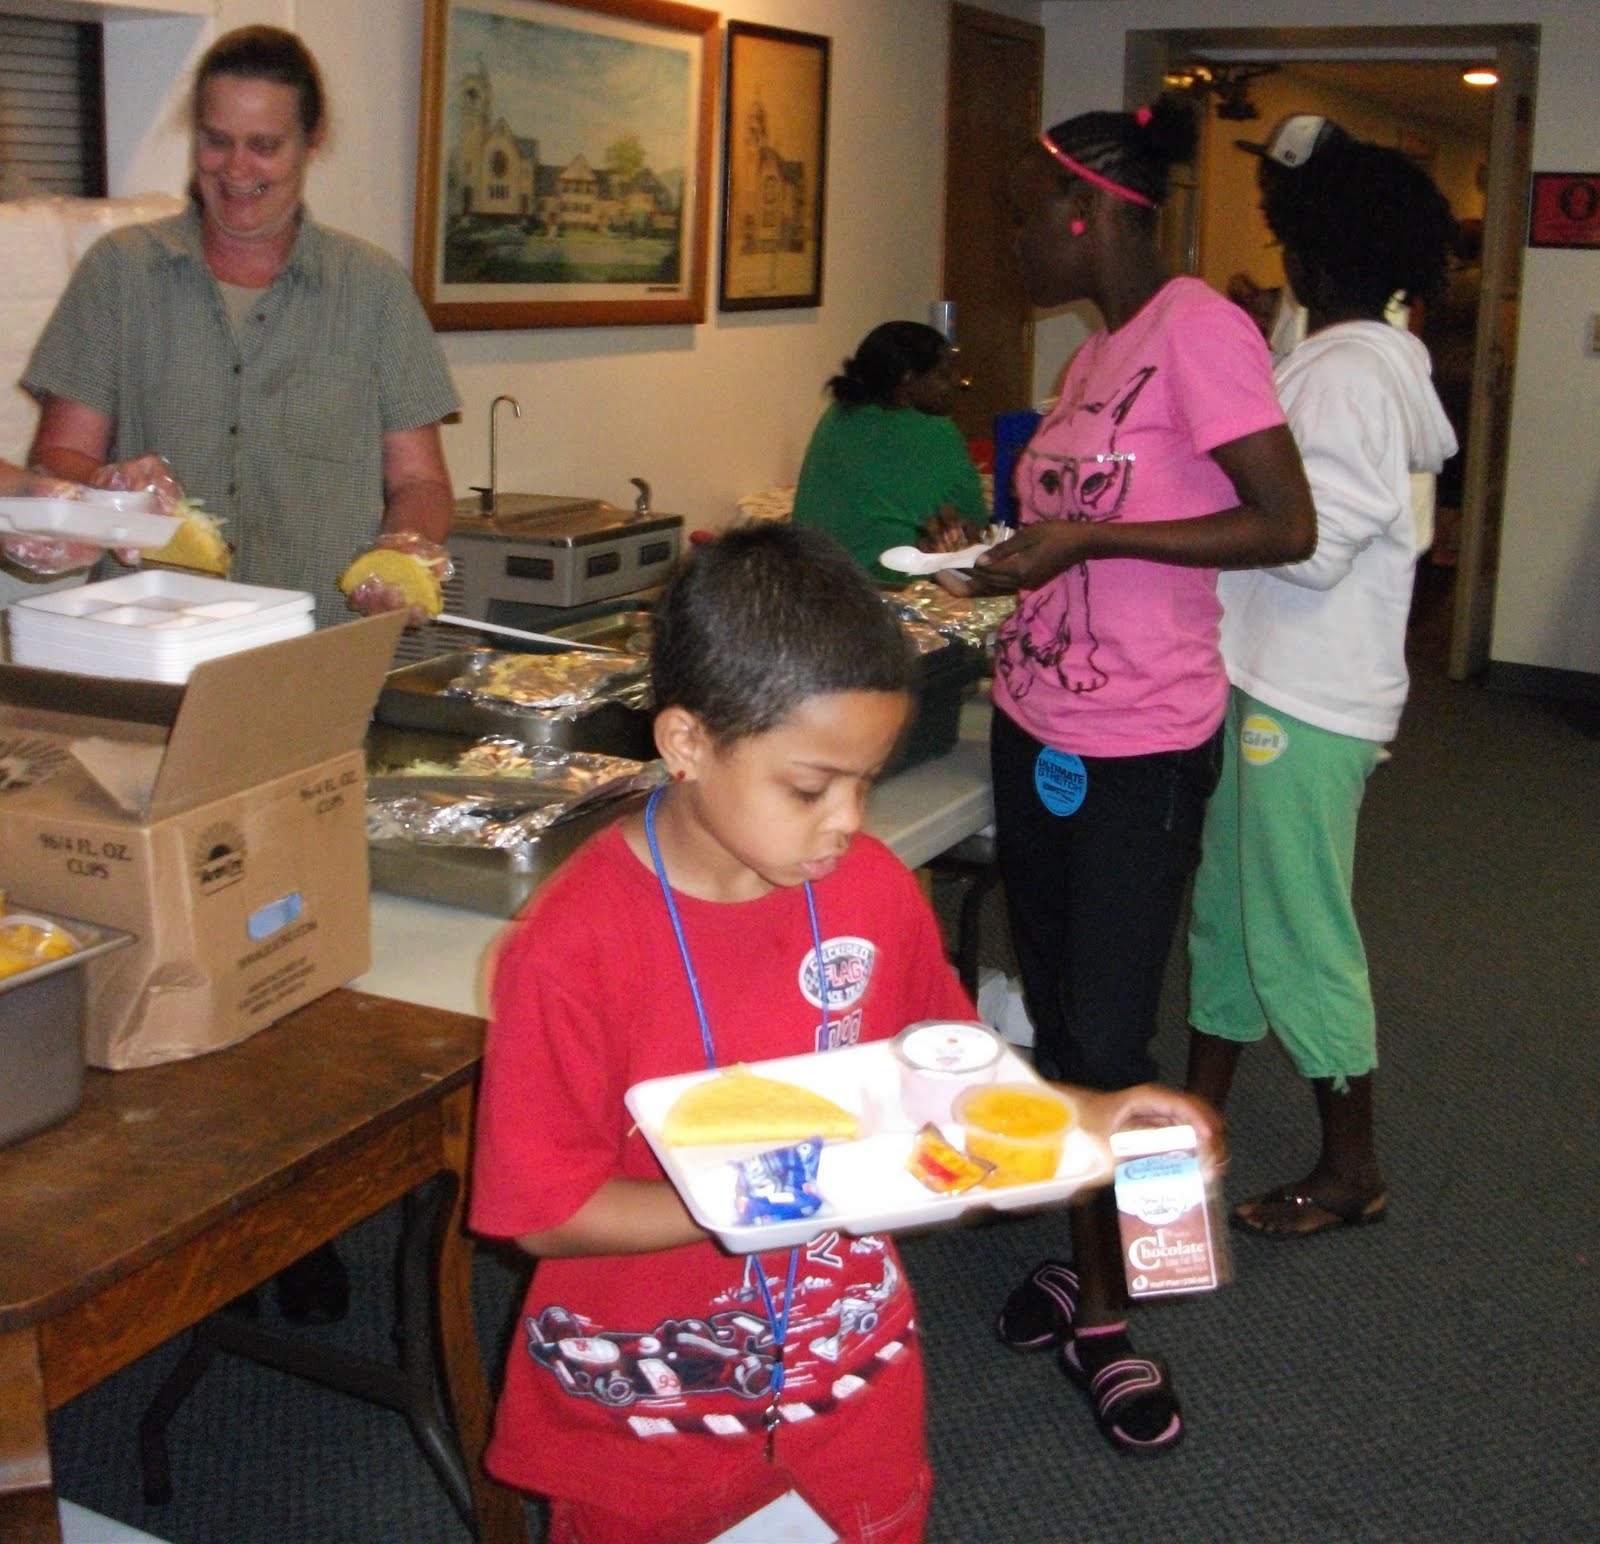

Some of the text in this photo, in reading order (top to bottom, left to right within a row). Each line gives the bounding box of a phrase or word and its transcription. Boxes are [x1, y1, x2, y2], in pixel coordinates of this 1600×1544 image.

[1242, 731, 1279, 749] Girl
[1037, 768, 1082, 794] STRETCH
[1038, 760, 1084, 784] ULTIMATE
[102, 842, 133, 861] OZ
[1129, 1236, 1205, 1270] Chocolate
